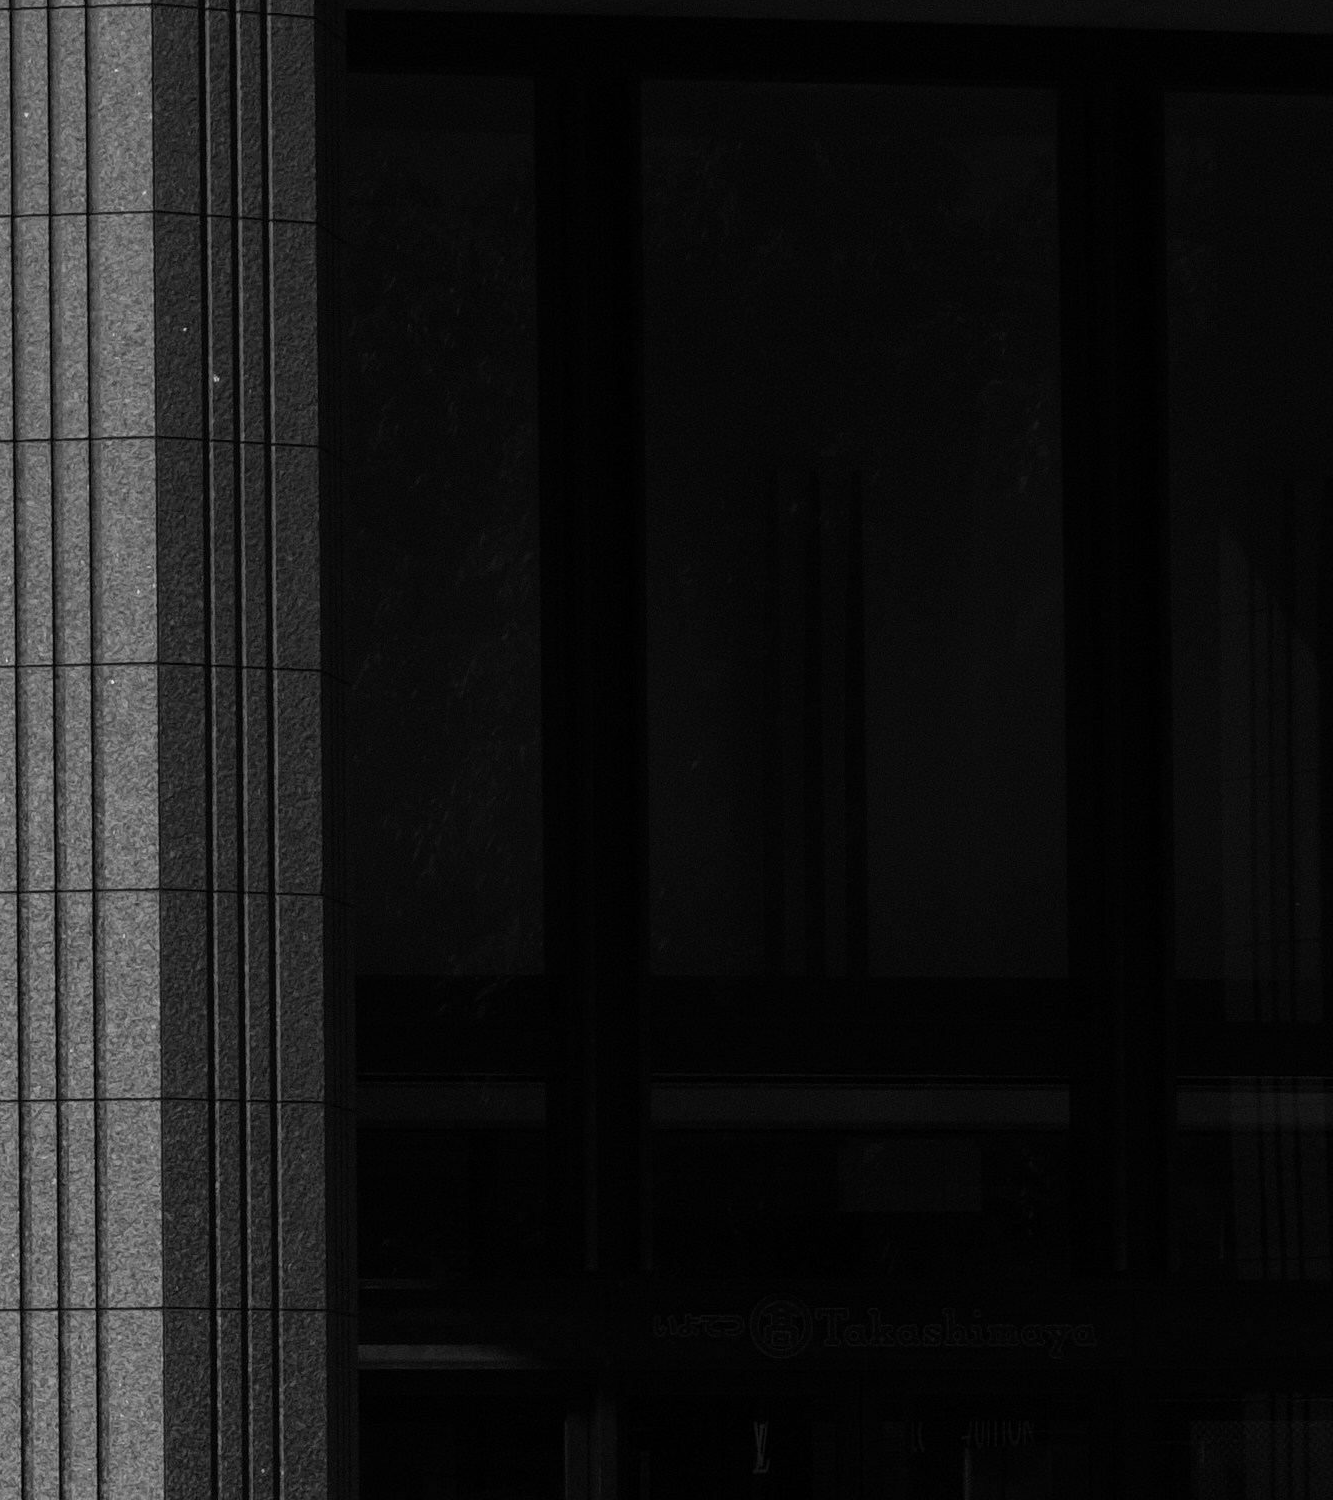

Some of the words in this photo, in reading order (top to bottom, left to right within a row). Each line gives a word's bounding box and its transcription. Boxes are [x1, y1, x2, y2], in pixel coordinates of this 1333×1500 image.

[651, 1312, 746, 1338] いよてつ
[814, 1306, 1098, 1359] Takashimaya
